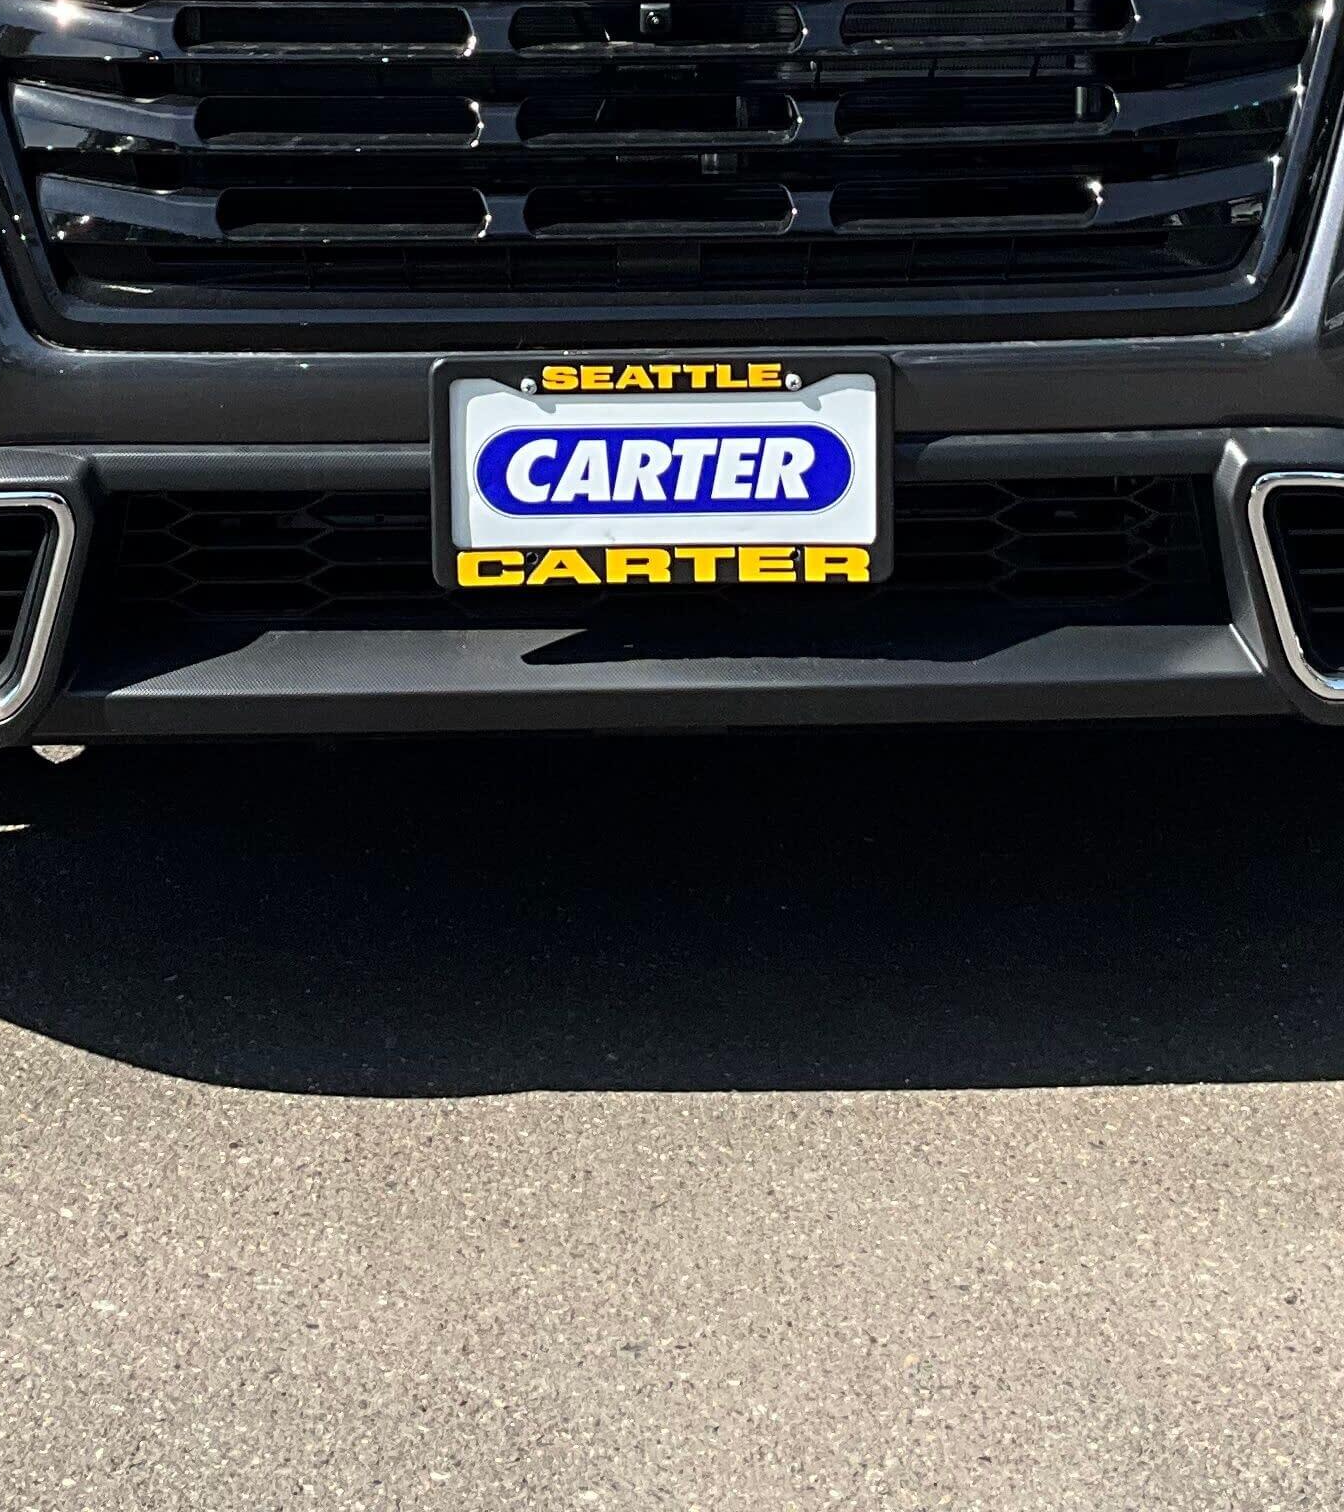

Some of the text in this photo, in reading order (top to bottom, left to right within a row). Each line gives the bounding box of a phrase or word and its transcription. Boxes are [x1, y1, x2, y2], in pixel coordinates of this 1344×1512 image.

[542, 363, 782, 391] SEATTLE
[506, 437, 816, 504] CARTER
[457, 546, 871, 587] CARTER
